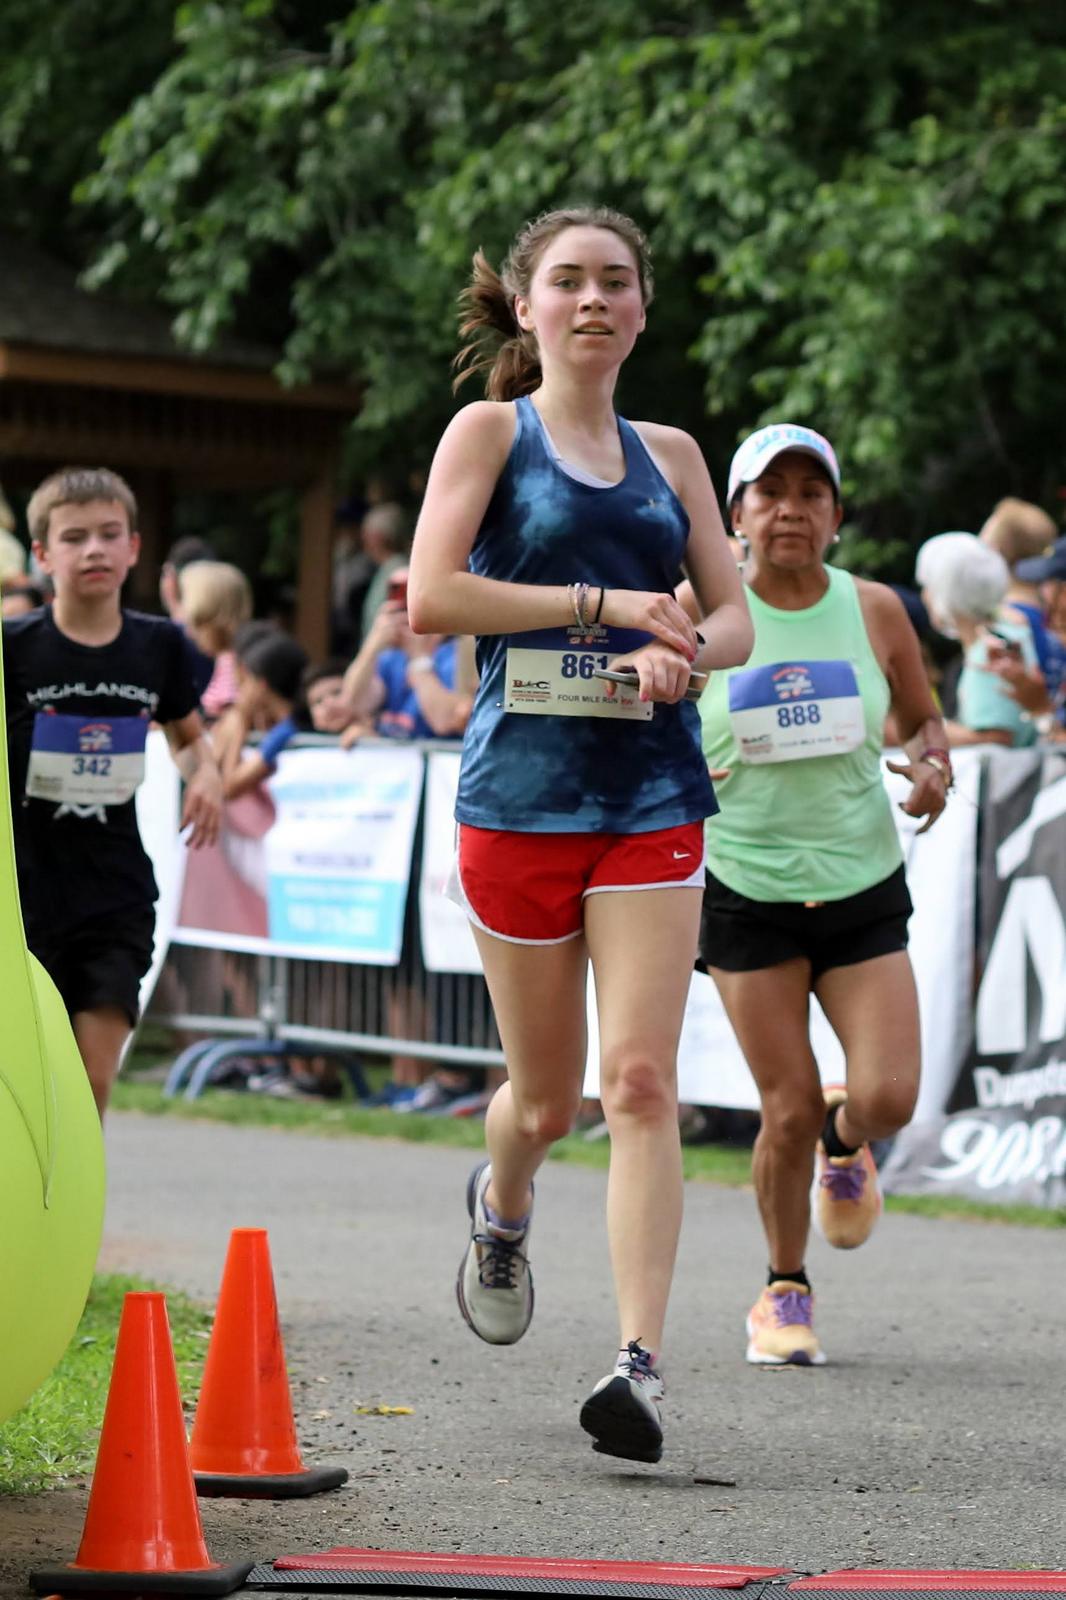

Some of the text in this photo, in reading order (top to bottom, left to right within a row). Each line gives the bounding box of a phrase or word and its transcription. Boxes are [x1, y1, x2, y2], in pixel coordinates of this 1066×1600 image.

[561, 653, 608, 679] 861
[557, 694, 580, 702] FOUR
[582, 695, 600, 703] MILE
[777, 703, 821, 728] 888
[72, 756, 112, 776] 342
